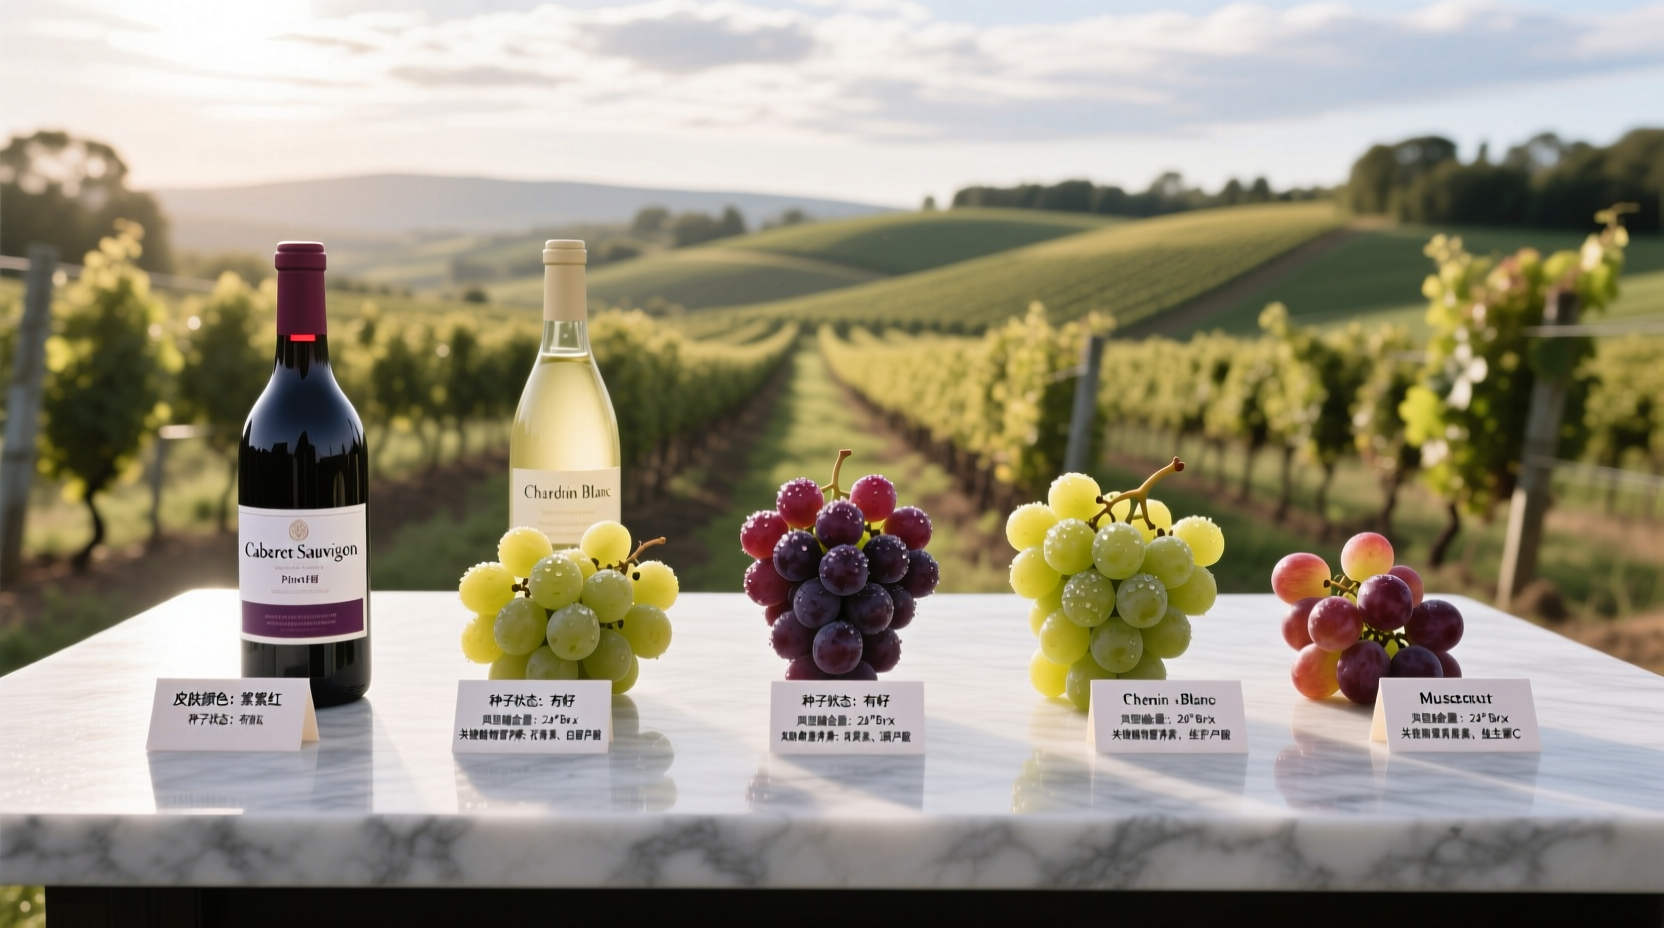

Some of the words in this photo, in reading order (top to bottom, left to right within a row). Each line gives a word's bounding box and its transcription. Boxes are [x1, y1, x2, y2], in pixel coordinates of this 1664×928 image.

[582, 484, 612, 499] Blanc
[297, 542, 358, 562] Sauvigon
[1122, 693, 1169, 706] Chenin
